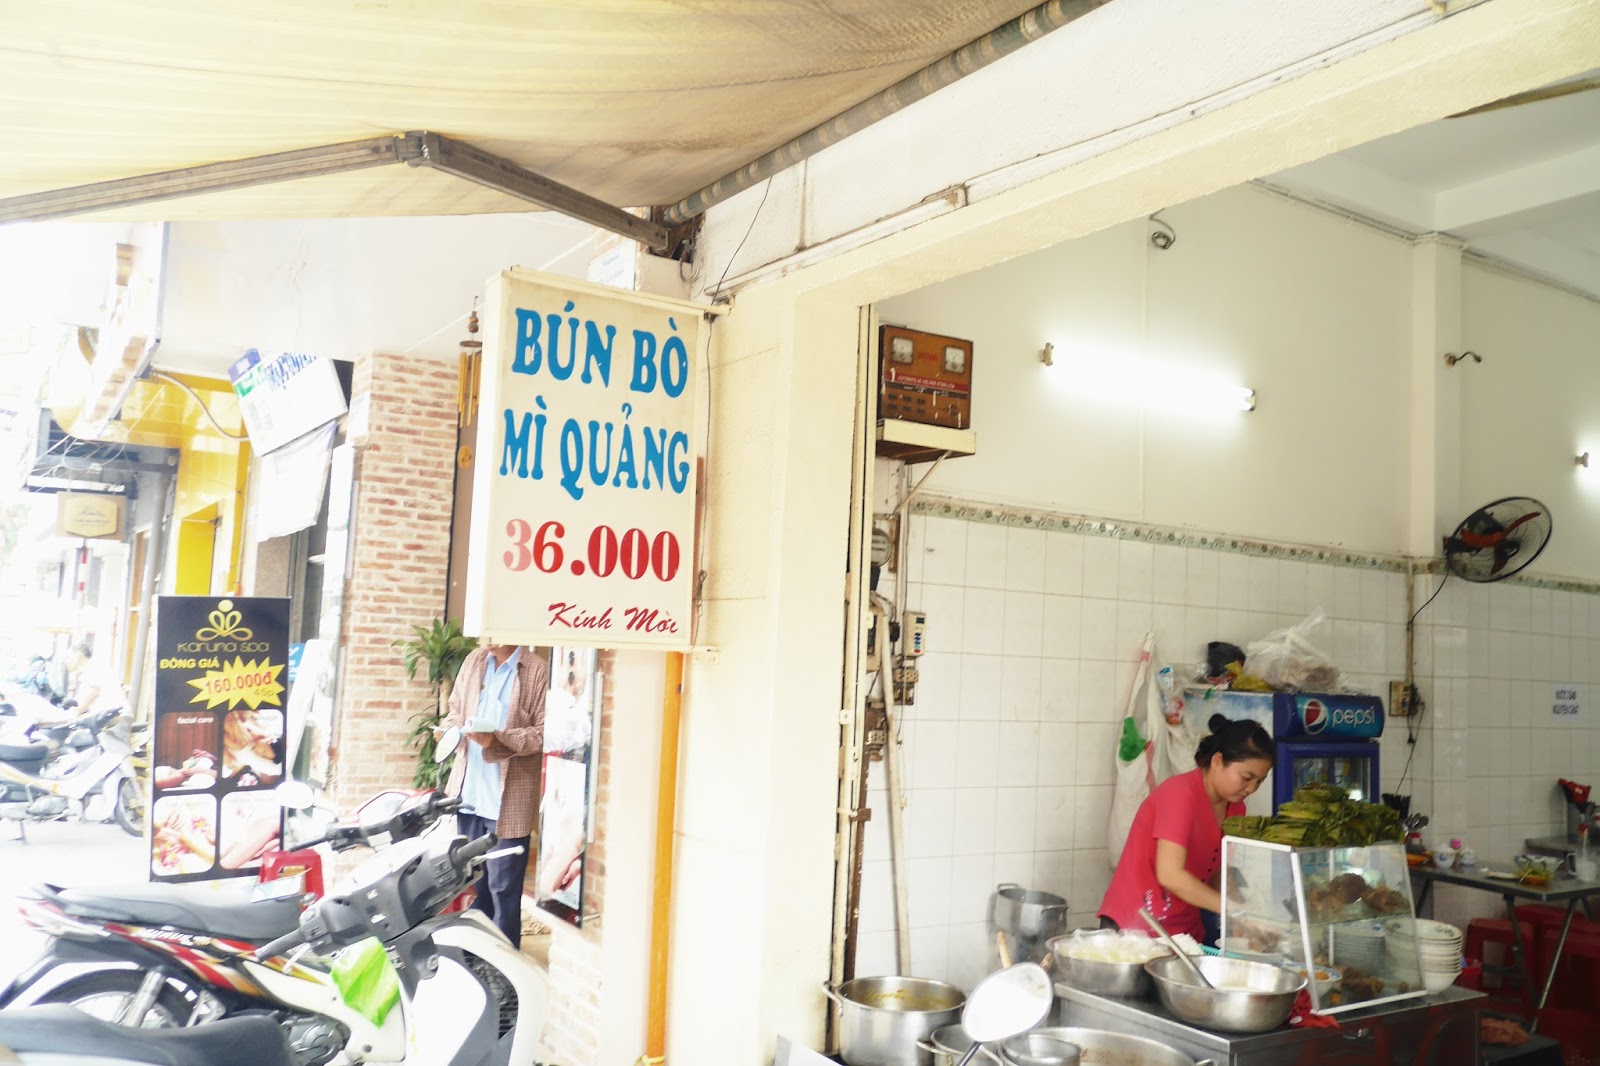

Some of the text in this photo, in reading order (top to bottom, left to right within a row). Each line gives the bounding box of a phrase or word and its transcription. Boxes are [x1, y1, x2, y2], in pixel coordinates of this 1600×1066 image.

[512, 300, 688, 398] BÚN BÒ
[500, 395, 690, 501] MÌ QUẢNG
[503, 518, 680, 582] 36.000
[548, 602, 613, 629] Kính
[198, 656, 220, 669] GIÁ
[1332, 705, 1375, 728] pepsi
